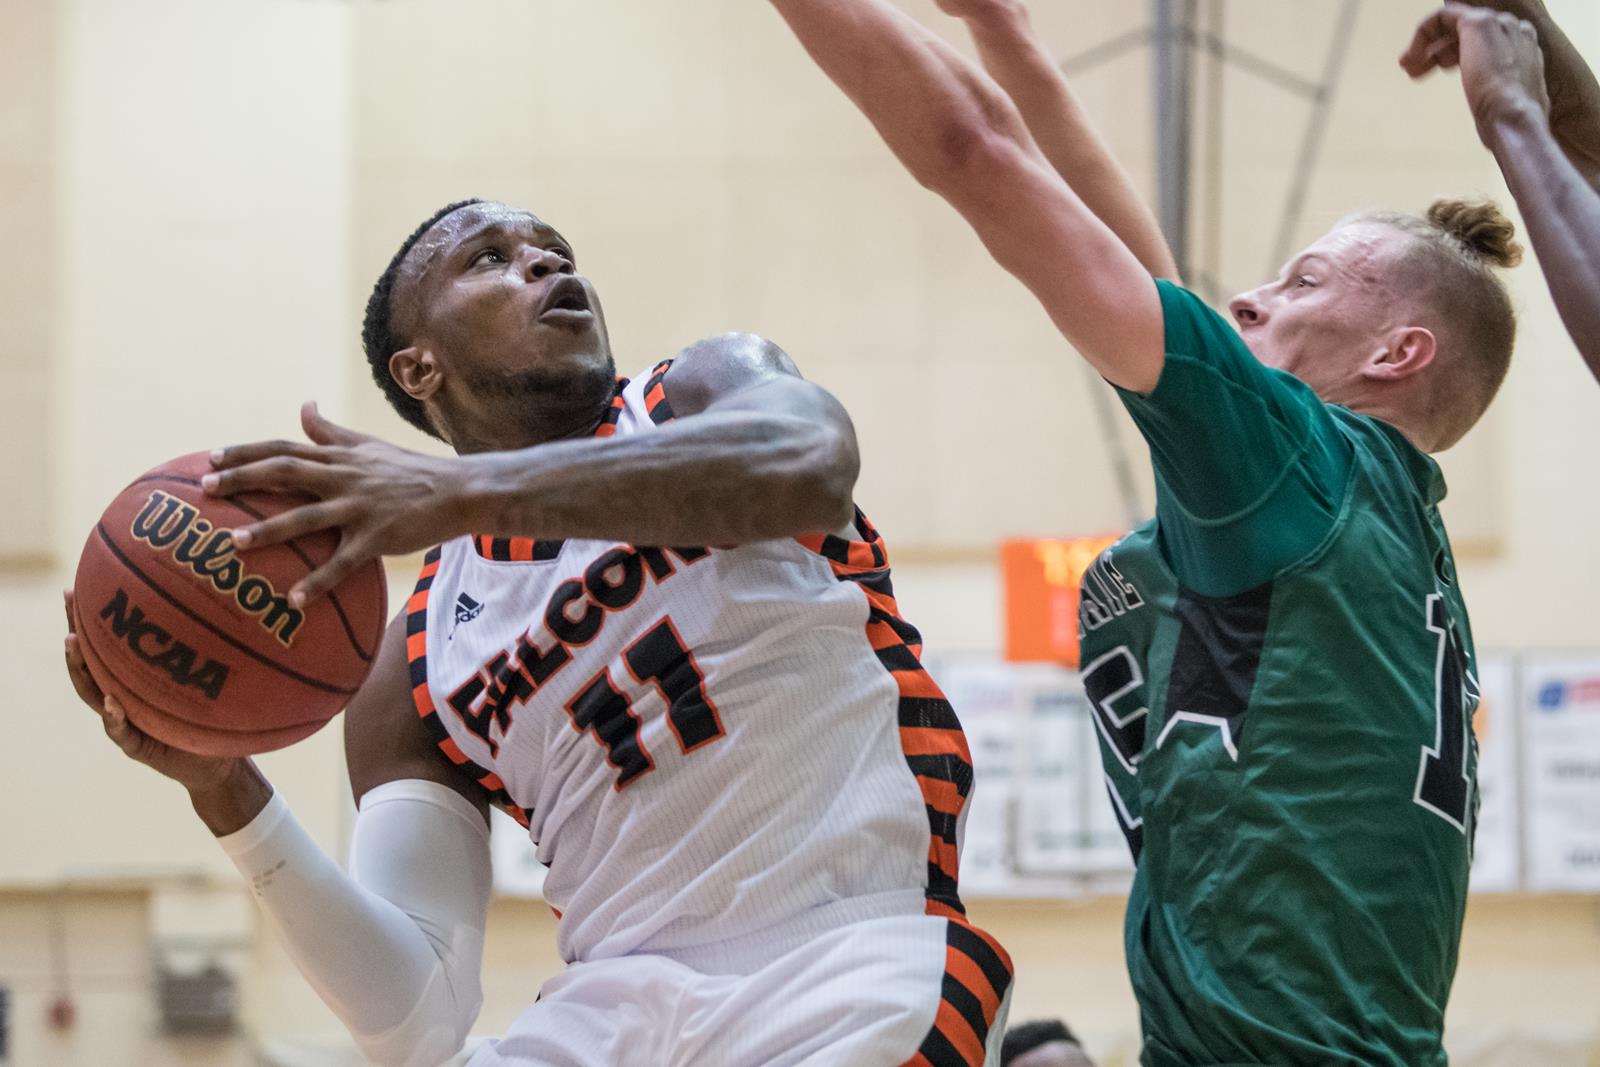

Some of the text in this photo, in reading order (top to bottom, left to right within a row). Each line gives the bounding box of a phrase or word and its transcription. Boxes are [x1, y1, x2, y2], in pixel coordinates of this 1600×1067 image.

[102, 587, 230, 700] NCAA
[131, 489, 304, 647] Wilson
[564, 615, 726, 793] 11
